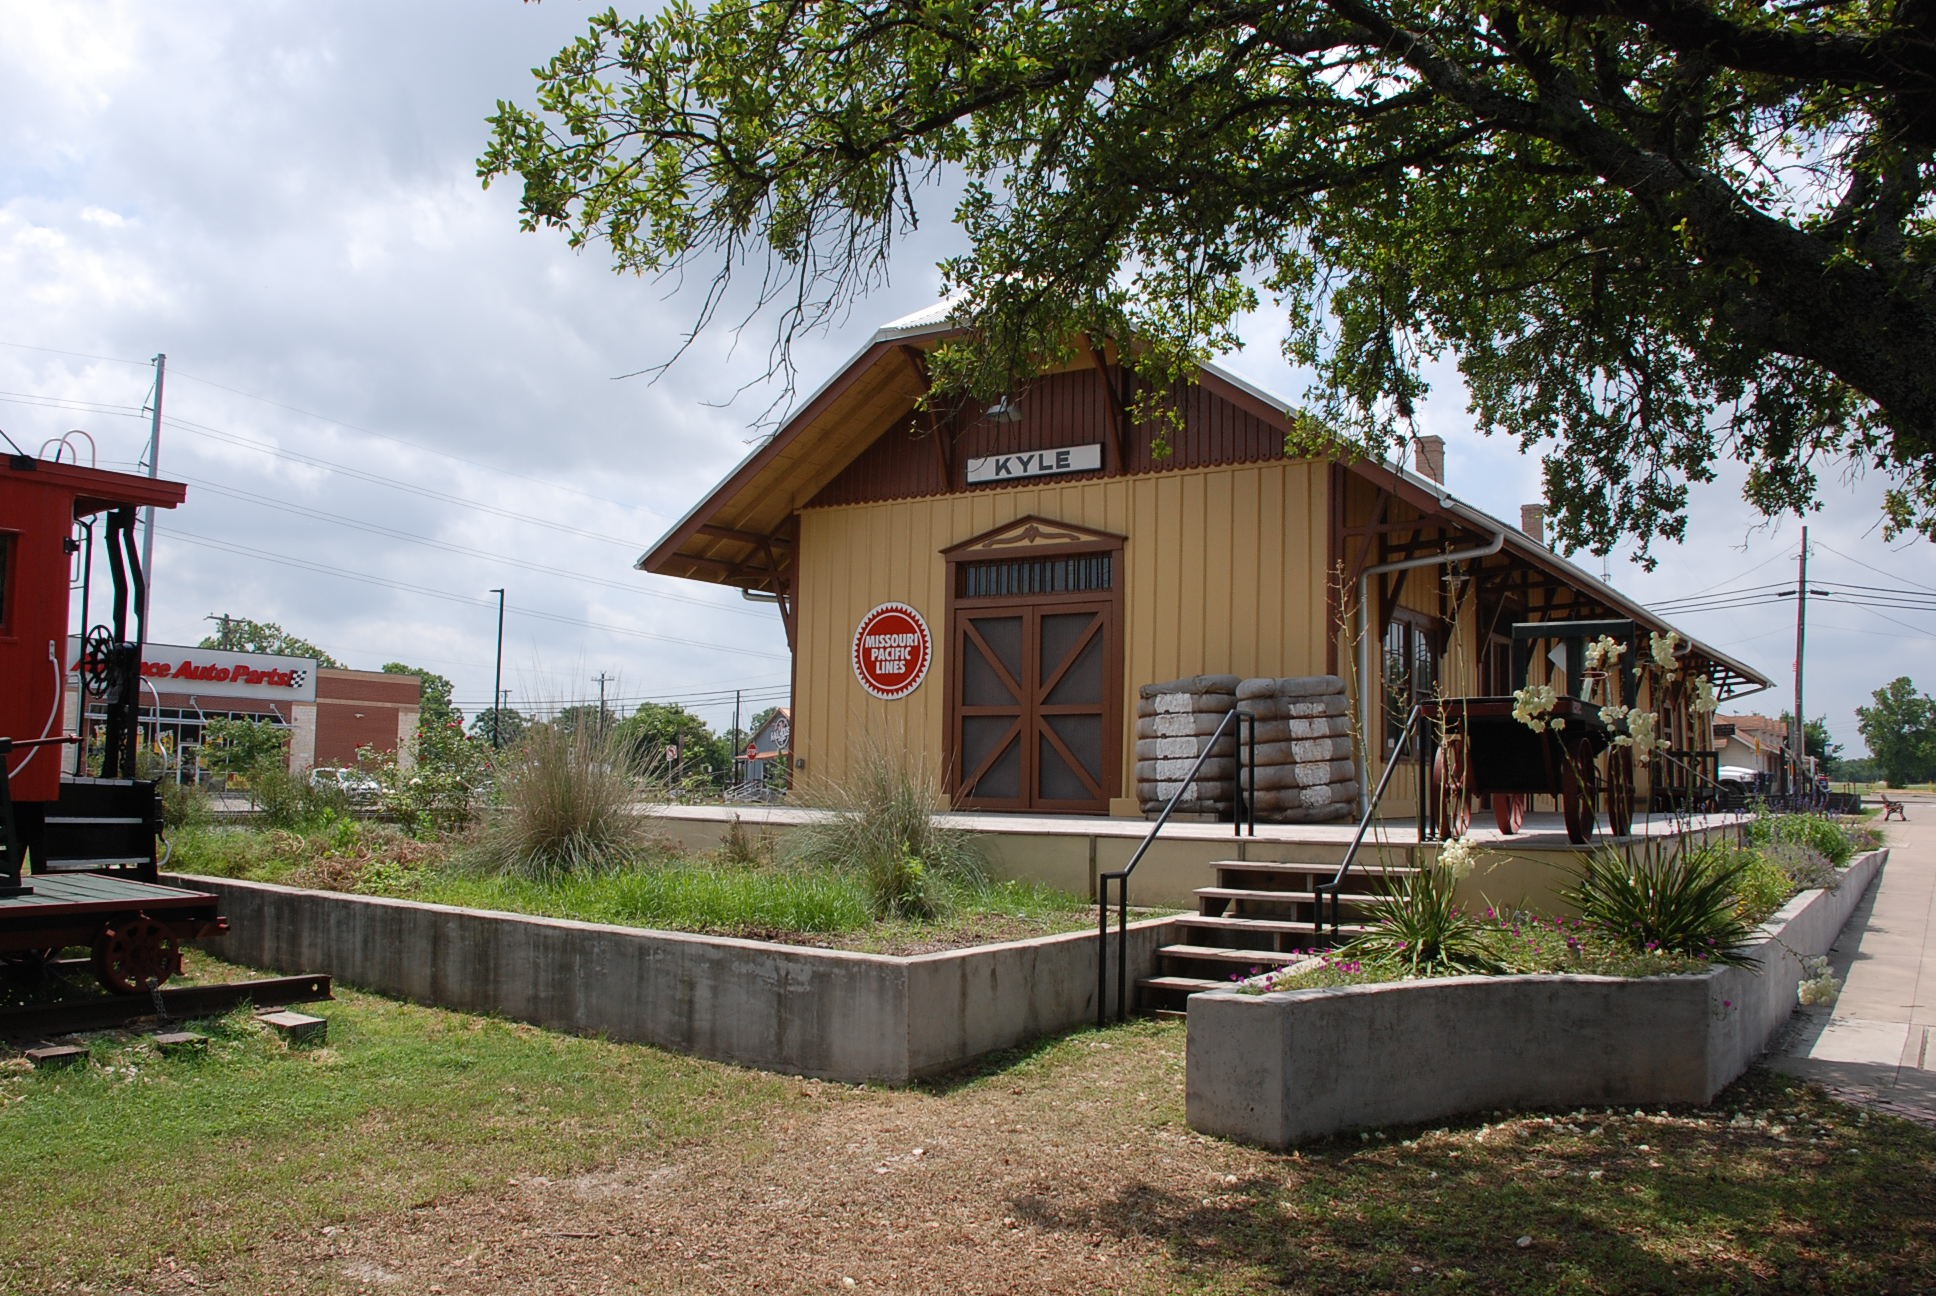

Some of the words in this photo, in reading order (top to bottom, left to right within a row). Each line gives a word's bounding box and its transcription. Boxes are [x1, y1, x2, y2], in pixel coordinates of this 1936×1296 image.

[995, 450, 1071, 477] KYLE
[865, 633, 919, 648] MISSOURI
[871, 647, 911, 661] PACIFIC
[172, 660, 231, 682] Auto
[230, 664, 292, 687] Parts
[875, 660, 906, 675] LINES
